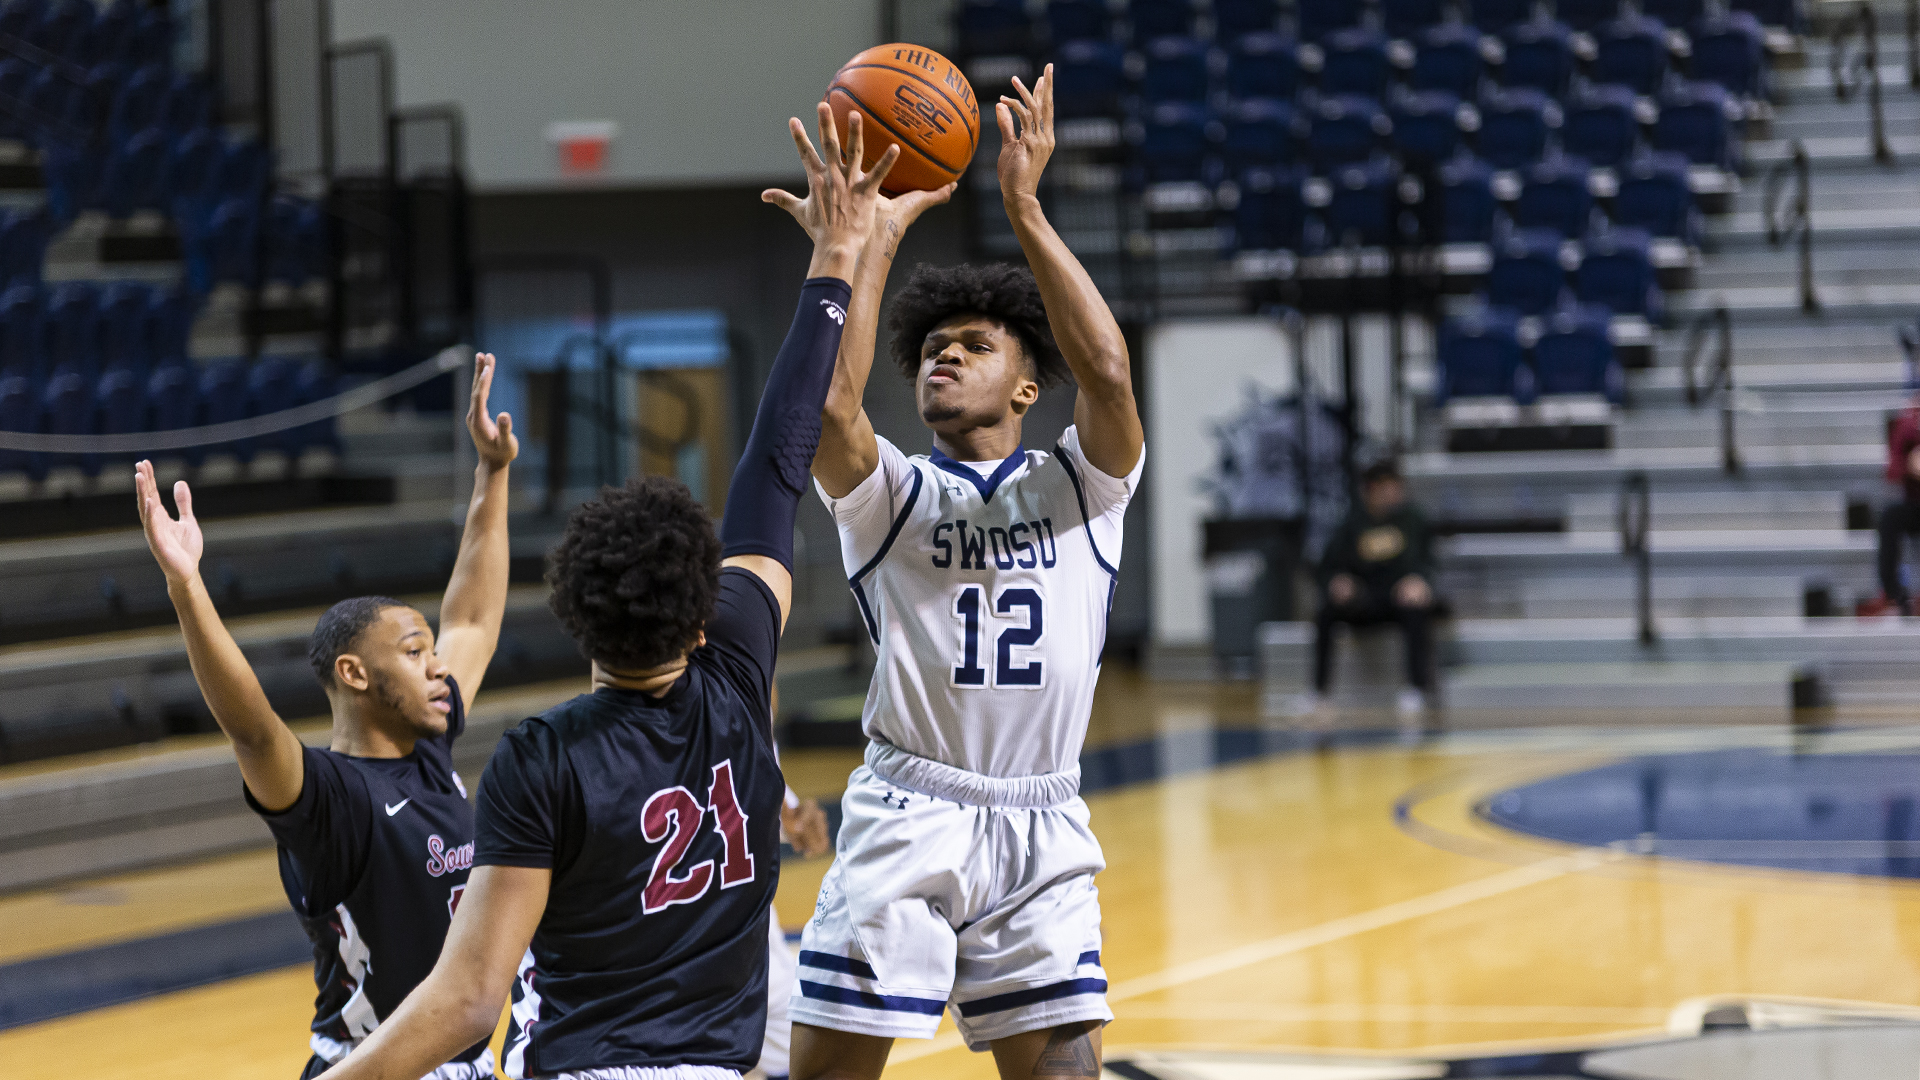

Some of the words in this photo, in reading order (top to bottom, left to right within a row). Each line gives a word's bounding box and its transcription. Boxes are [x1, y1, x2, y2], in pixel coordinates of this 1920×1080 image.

[893, 49, 938, 73] THE
[943, 65, 979, 121] ROCK
[932, 518, 1057, 570] SWOSU
[952, 585, 1046, 689] 12
[426, 834, 475, 878] Sou
[640, 758, 755, 915] 21
